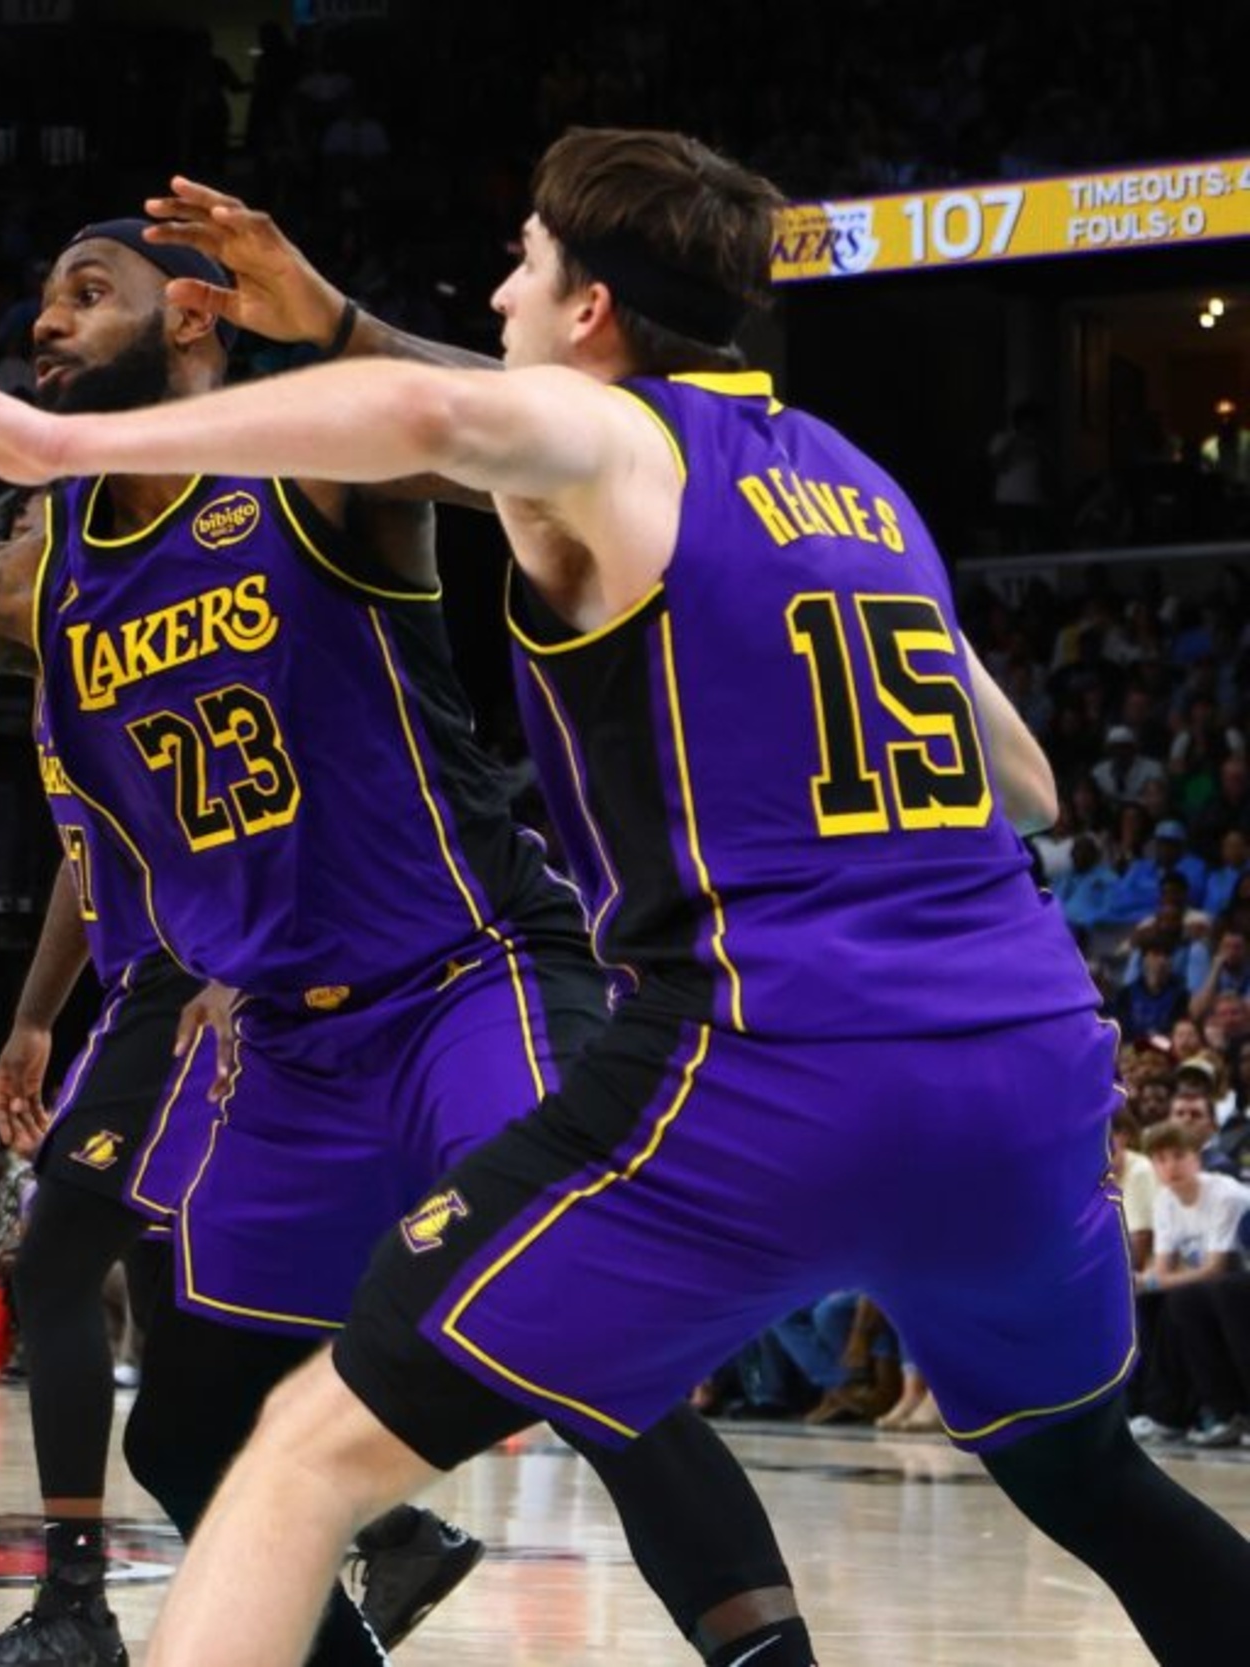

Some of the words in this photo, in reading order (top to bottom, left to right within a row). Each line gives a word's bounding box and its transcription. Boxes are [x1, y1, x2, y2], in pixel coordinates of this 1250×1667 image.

[903, 189, 1024, 262] 107
[1069, 209, 1175, 245] FOULS:
[1181, 205, 1205, 236] 0
[1070, 166, 1234, 209] TIMEOUTS:
[769, 226, 867, 274] KERS
[737, 468, 905, 554] REAVES
[65, 573, 280, 711] LAKERS
[784, 592, 993, 837] 15
[125, 683, 302, 853] 23
